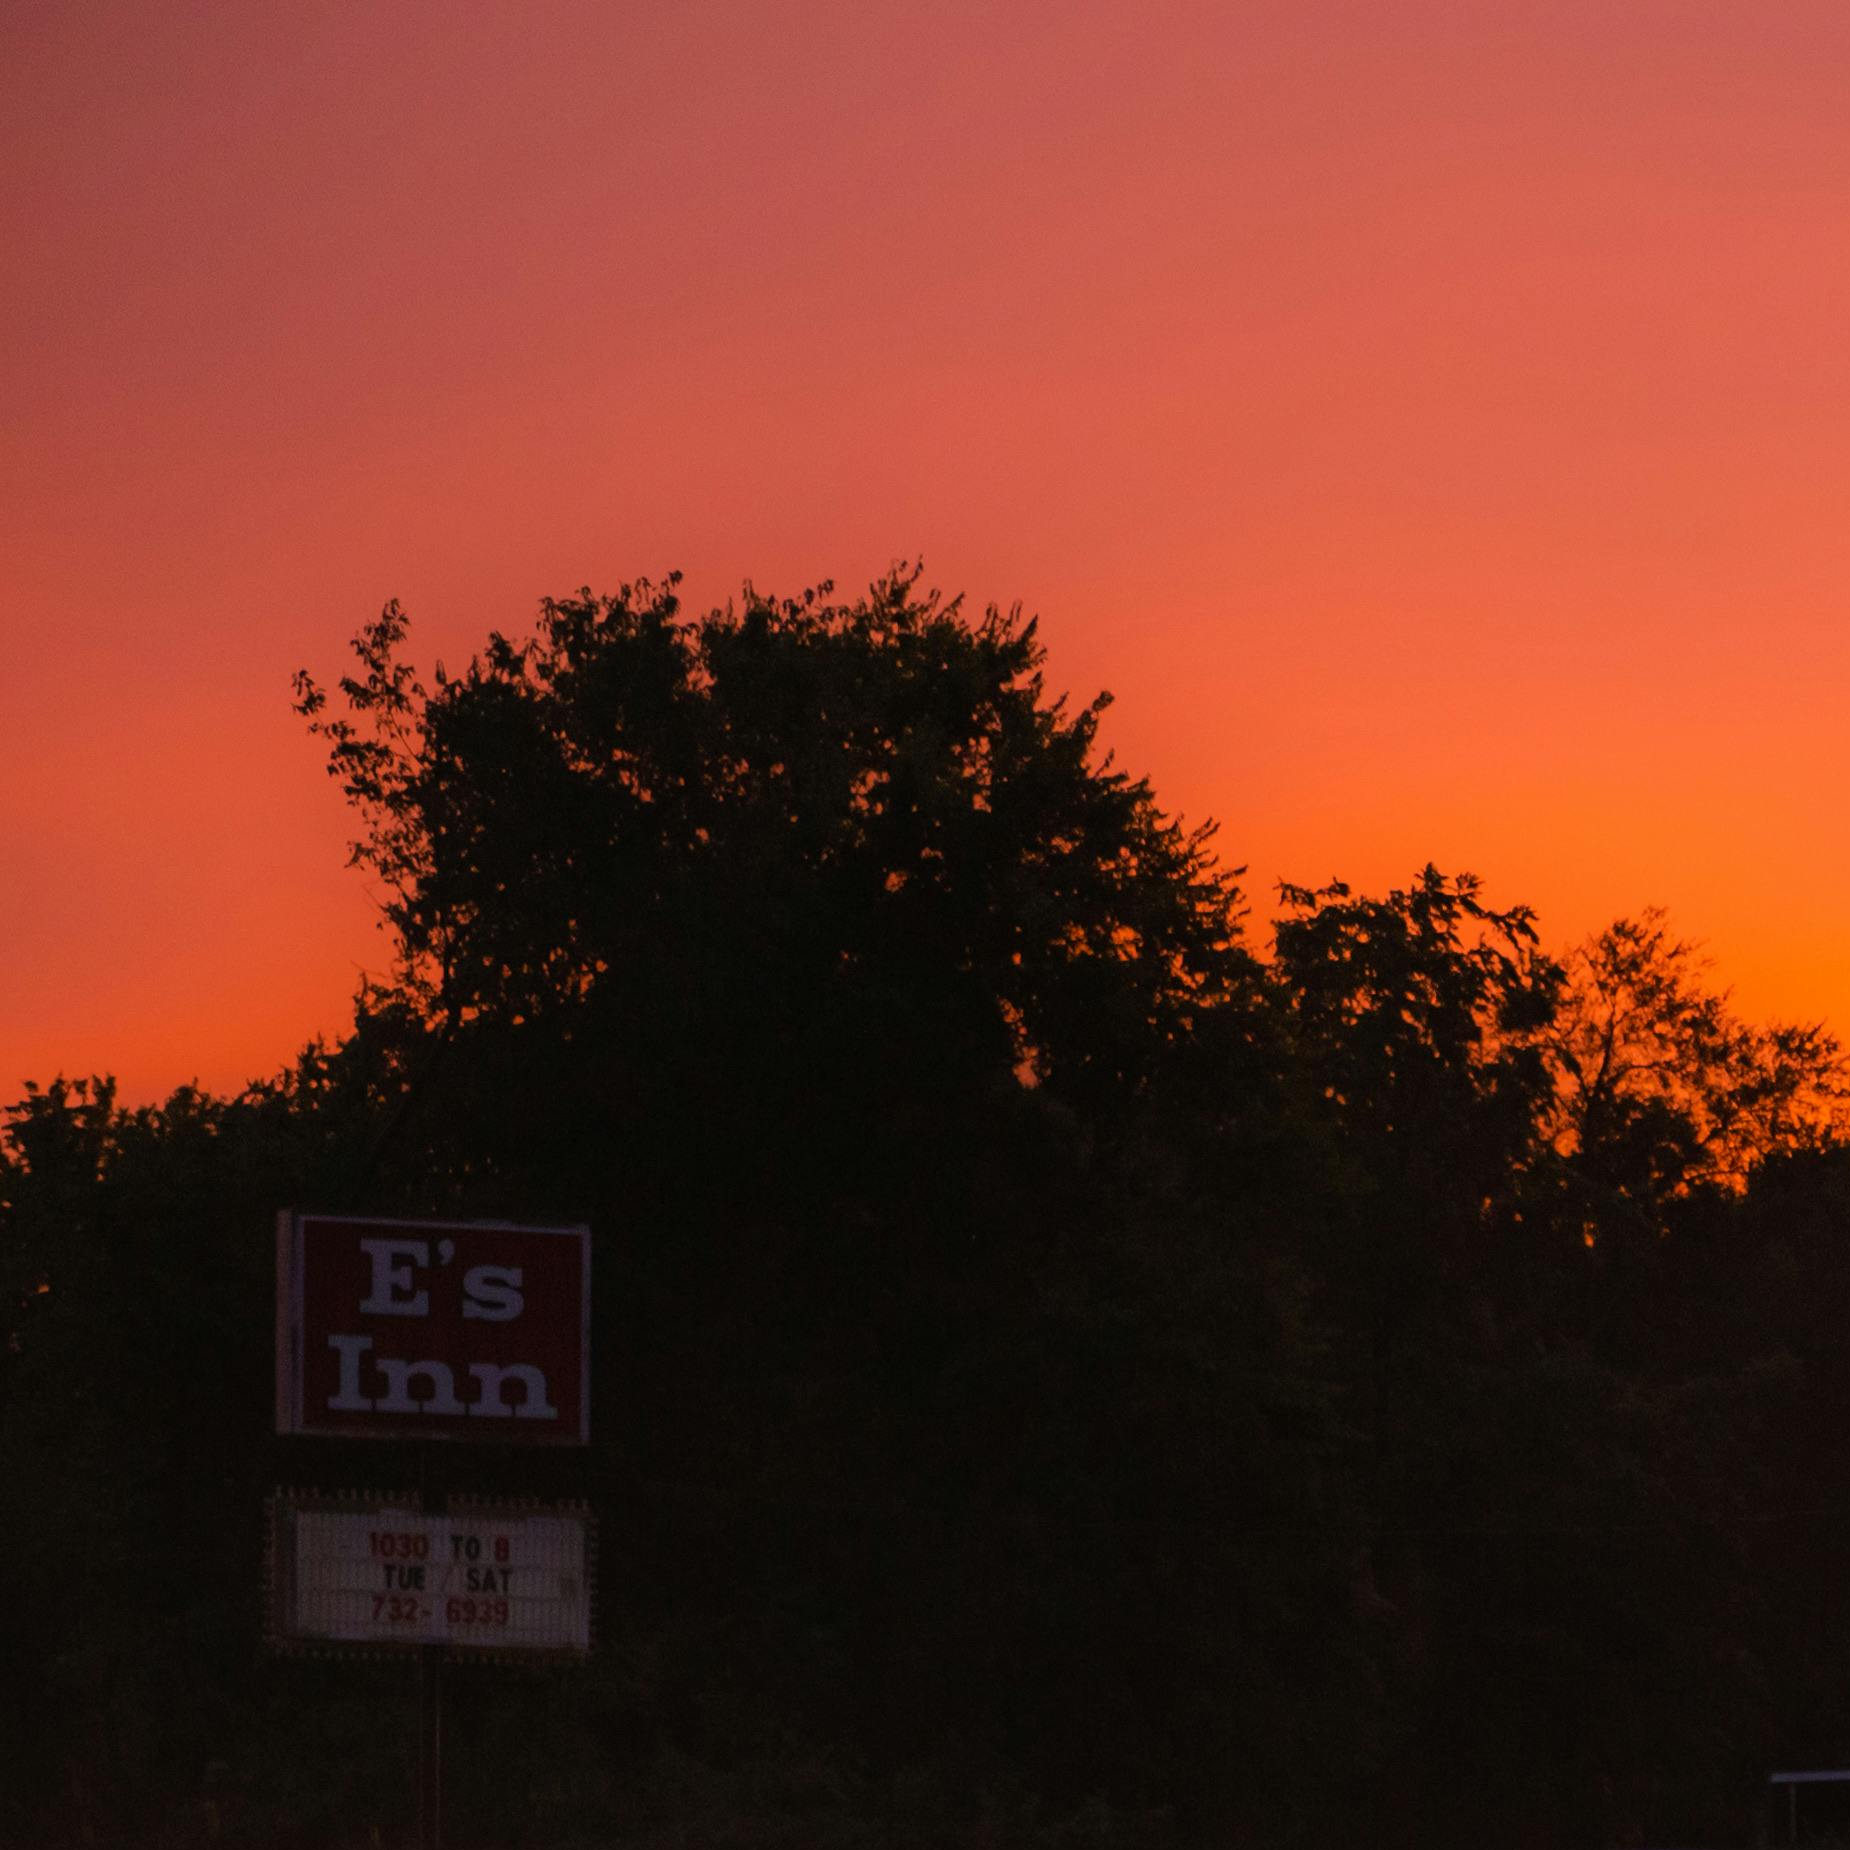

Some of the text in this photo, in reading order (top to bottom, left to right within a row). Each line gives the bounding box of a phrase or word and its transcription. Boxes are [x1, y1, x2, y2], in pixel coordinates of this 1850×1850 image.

[359, 1236, 525, 1323] E's
[327, 1334, 558, 1421] Inn
[370, 1532, 429, 1559] 1030
[450, 1535, 480, 1561] TO
[384, 1564, 425, 1590] TUE
[467, 1566, 512, 1593] SAT
